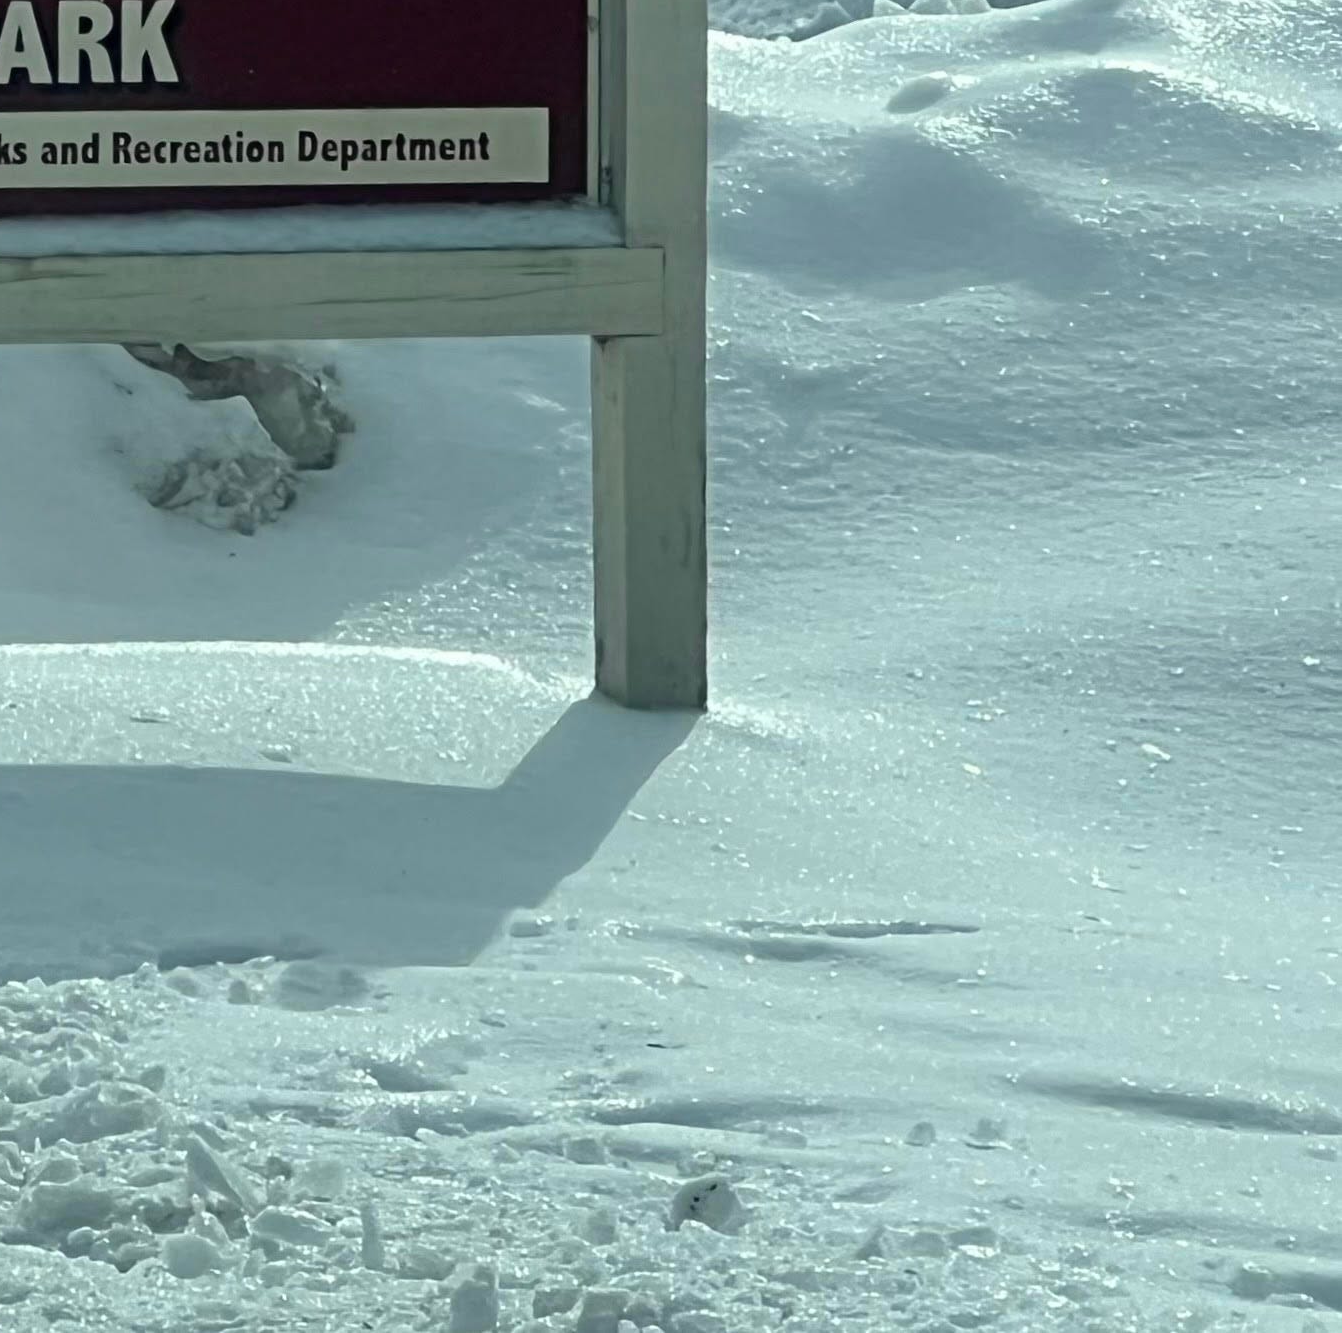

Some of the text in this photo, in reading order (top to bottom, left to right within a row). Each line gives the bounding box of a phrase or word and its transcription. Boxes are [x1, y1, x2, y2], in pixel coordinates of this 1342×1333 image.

[41, 133, 99, 164] and
[113, 131, 284, 164] Recreation
[299, 131, 489, 171] Department
